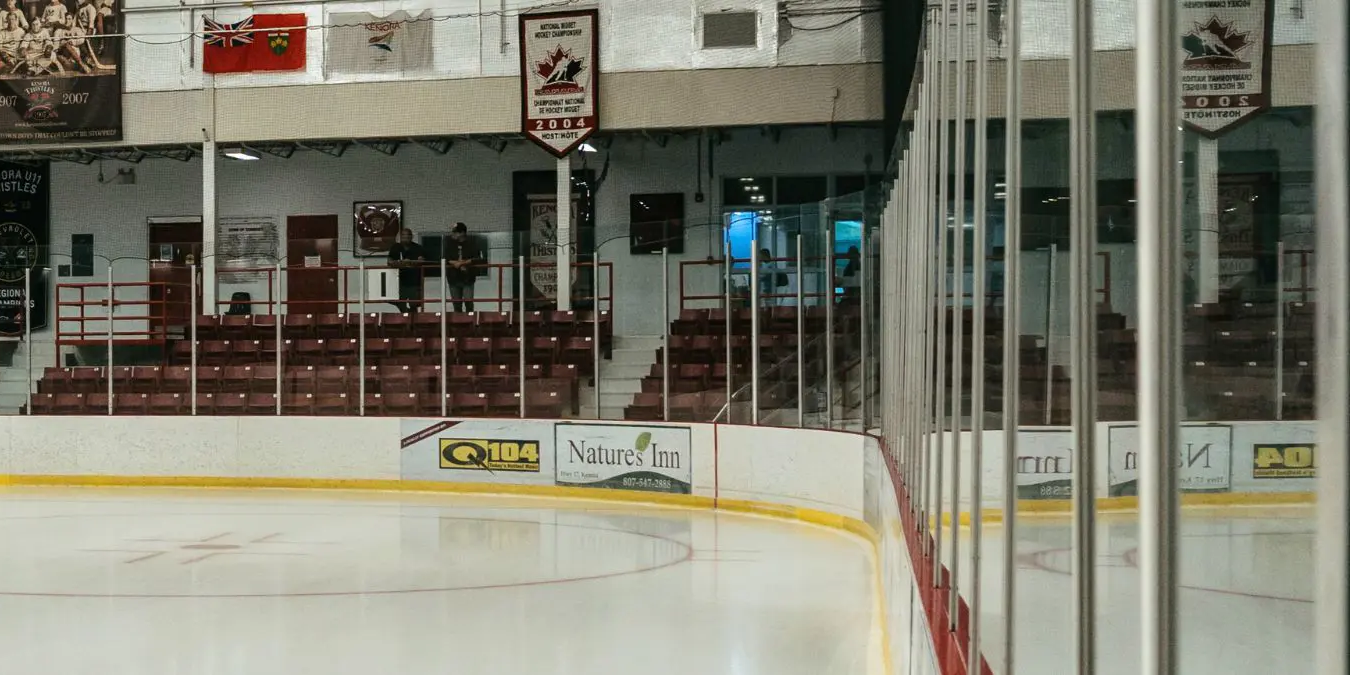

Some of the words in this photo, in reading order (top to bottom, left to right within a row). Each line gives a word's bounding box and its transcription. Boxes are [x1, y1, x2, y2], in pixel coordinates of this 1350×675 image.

[62, 93, 90, 105] 2007
[536, 118, 585, 130] 2004
[25, 171, 42, 185] U11
[651, 443, 681, 468] Inn
